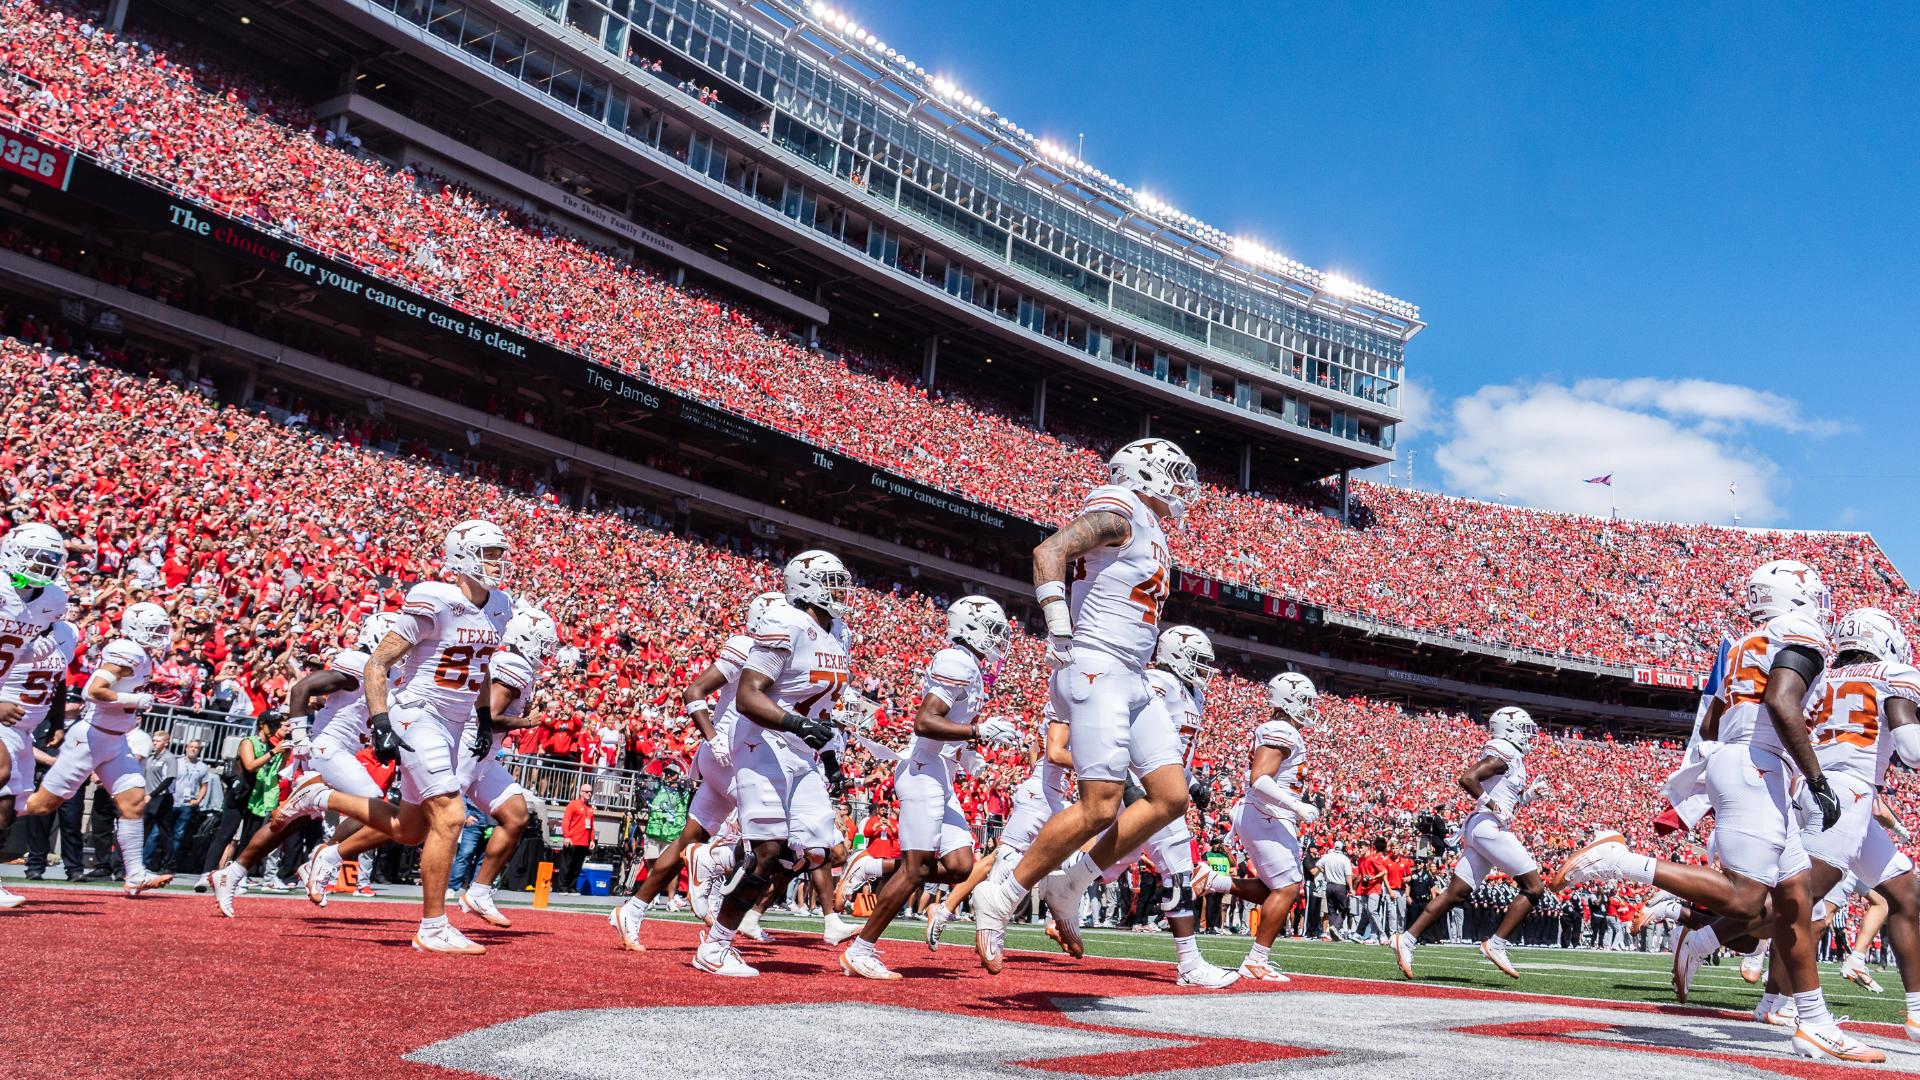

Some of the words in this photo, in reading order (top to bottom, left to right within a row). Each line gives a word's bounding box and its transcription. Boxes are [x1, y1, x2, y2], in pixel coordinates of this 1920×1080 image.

[563, 195, 578, 208] The
[582, 203, 607, 222] Shelly
[611, 216, 638, 236] Family
[641, 232, 674, 252] Pressbox
[169, 204, 211, 236] The
[214, 227, 280, 263] choice
[285, 251, 316, 276] for
[316, 267, 363, 294] your
[365, 287, 426, 319] cancer
[428, 311, 465, 334] care
[468, 322, 482, 341] is
[484, 332, 527, 358] clear.
[586, 368, 613, 391] The
[615, 381, 660, 409] James
[812, 452, 834, 470] The
[871, 473, 887, 488] for
[888, 481, 913, 497] your
[914, 490, 947, 509] cancer
[948, 502, 970, 517] care
[971, 507, 979, 520] is
[980, 511, 1005, 529] clear.
[456, 627, 500, 645] TEXAS
[1656, 672, 1688, 687] SMITH
